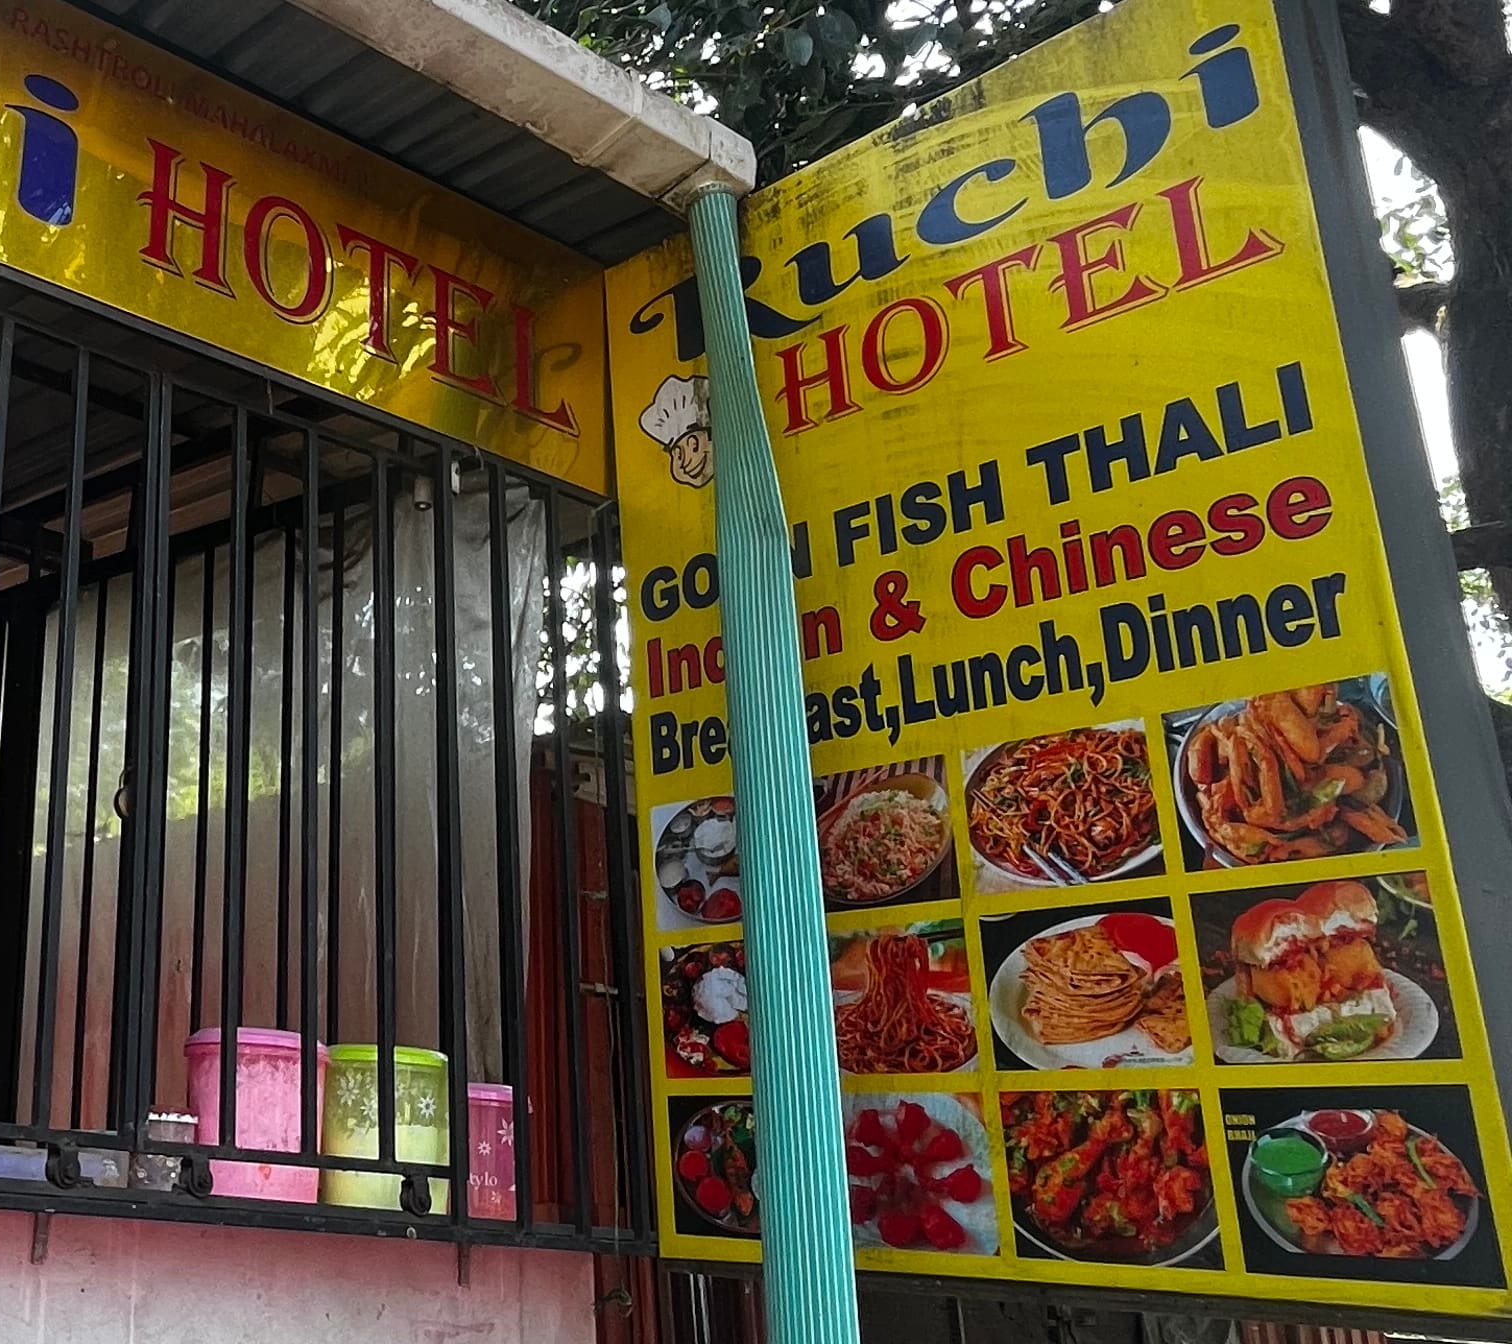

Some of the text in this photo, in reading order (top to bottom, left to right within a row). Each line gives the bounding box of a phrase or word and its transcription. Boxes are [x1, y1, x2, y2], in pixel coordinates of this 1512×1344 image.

[136, 138, 580, 438] HOTEL
[775, 176, 1285, 438] HOTEL
[641, 360, 1315, 622] GON FISH THALI
[646, 474, 1333, 699] Indn & Chinese
[469, 1171, 498, 1191] tylo
